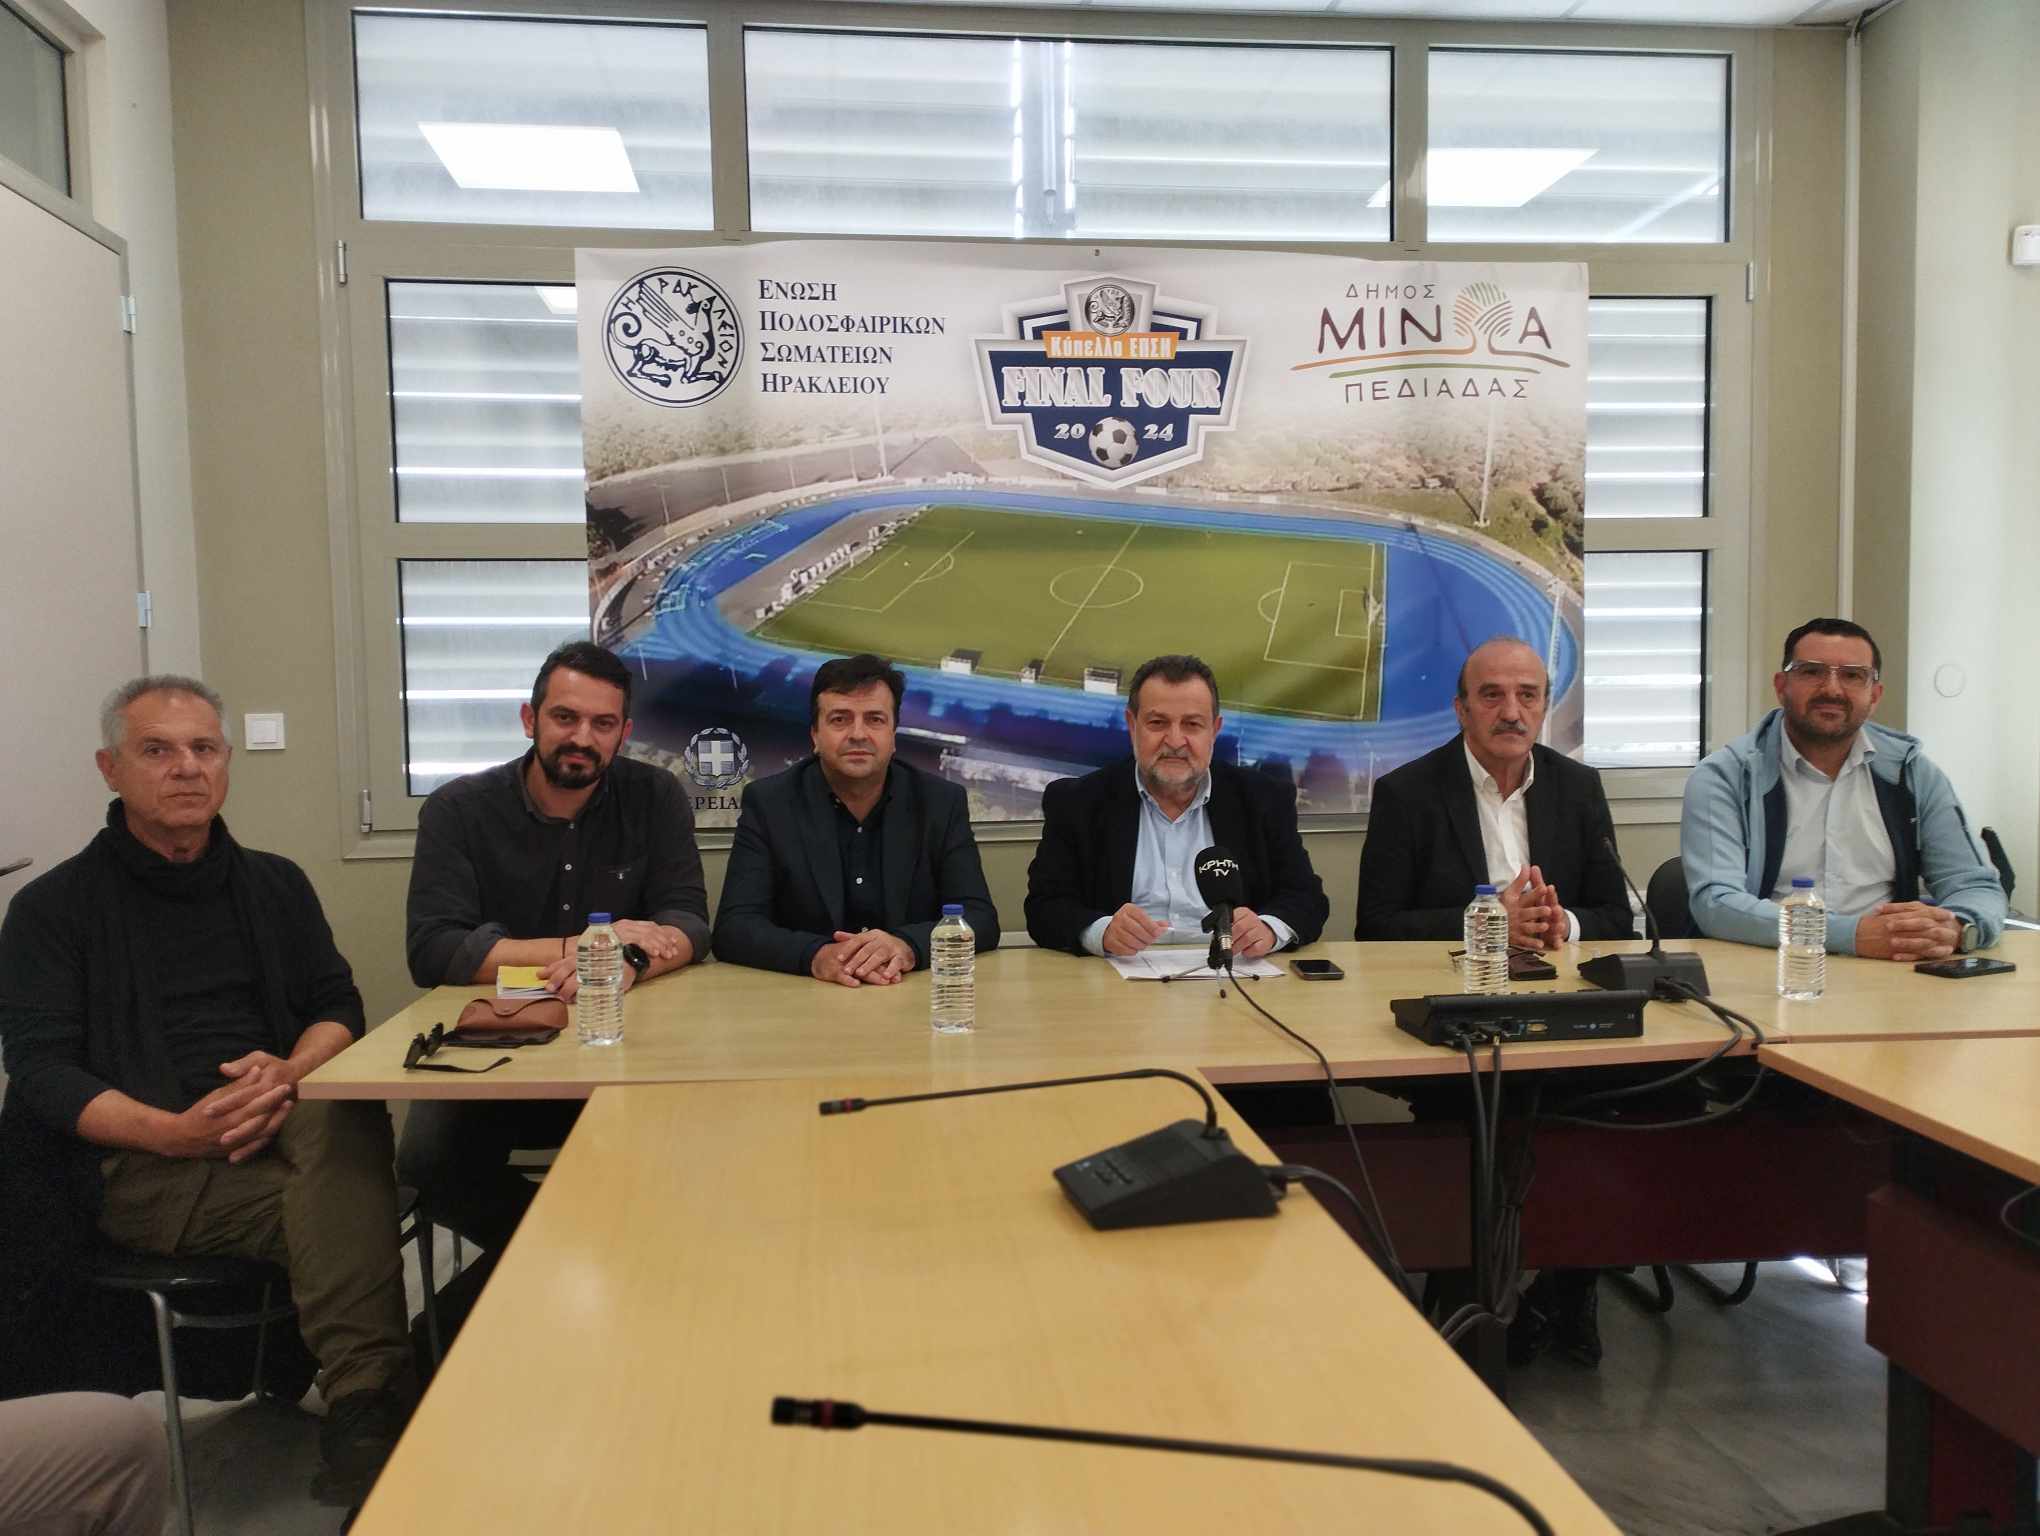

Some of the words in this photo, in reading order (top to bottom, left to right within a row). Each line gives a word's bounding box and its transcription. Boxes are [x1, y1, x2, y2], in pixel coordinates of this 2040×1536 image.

[758, 279, 837, 302] ΕΝΩΣΗ
[1346, 283, 1436, 299] ΔΗΜΟΣ
[759, 311, 946, 336] ΠΟΔΟΣΦΑΙΡΙΚΩΝ
[760, 342, 893, 365] ΣΩΜΑΤΕΙΩΝ
[761, 372, 891, 395] ΗΡΑΚΛΕΙΟΥ
[1001, 366, 1112, 408] FINAL
[1120, 367, 1222, 409] FOUR
[1345, 377, 1530, 404] ΠΕΔΙΑΔΑΣ
[1053, 423, 1087, 440] 20
[1143, 423, 1174, 442] 24
